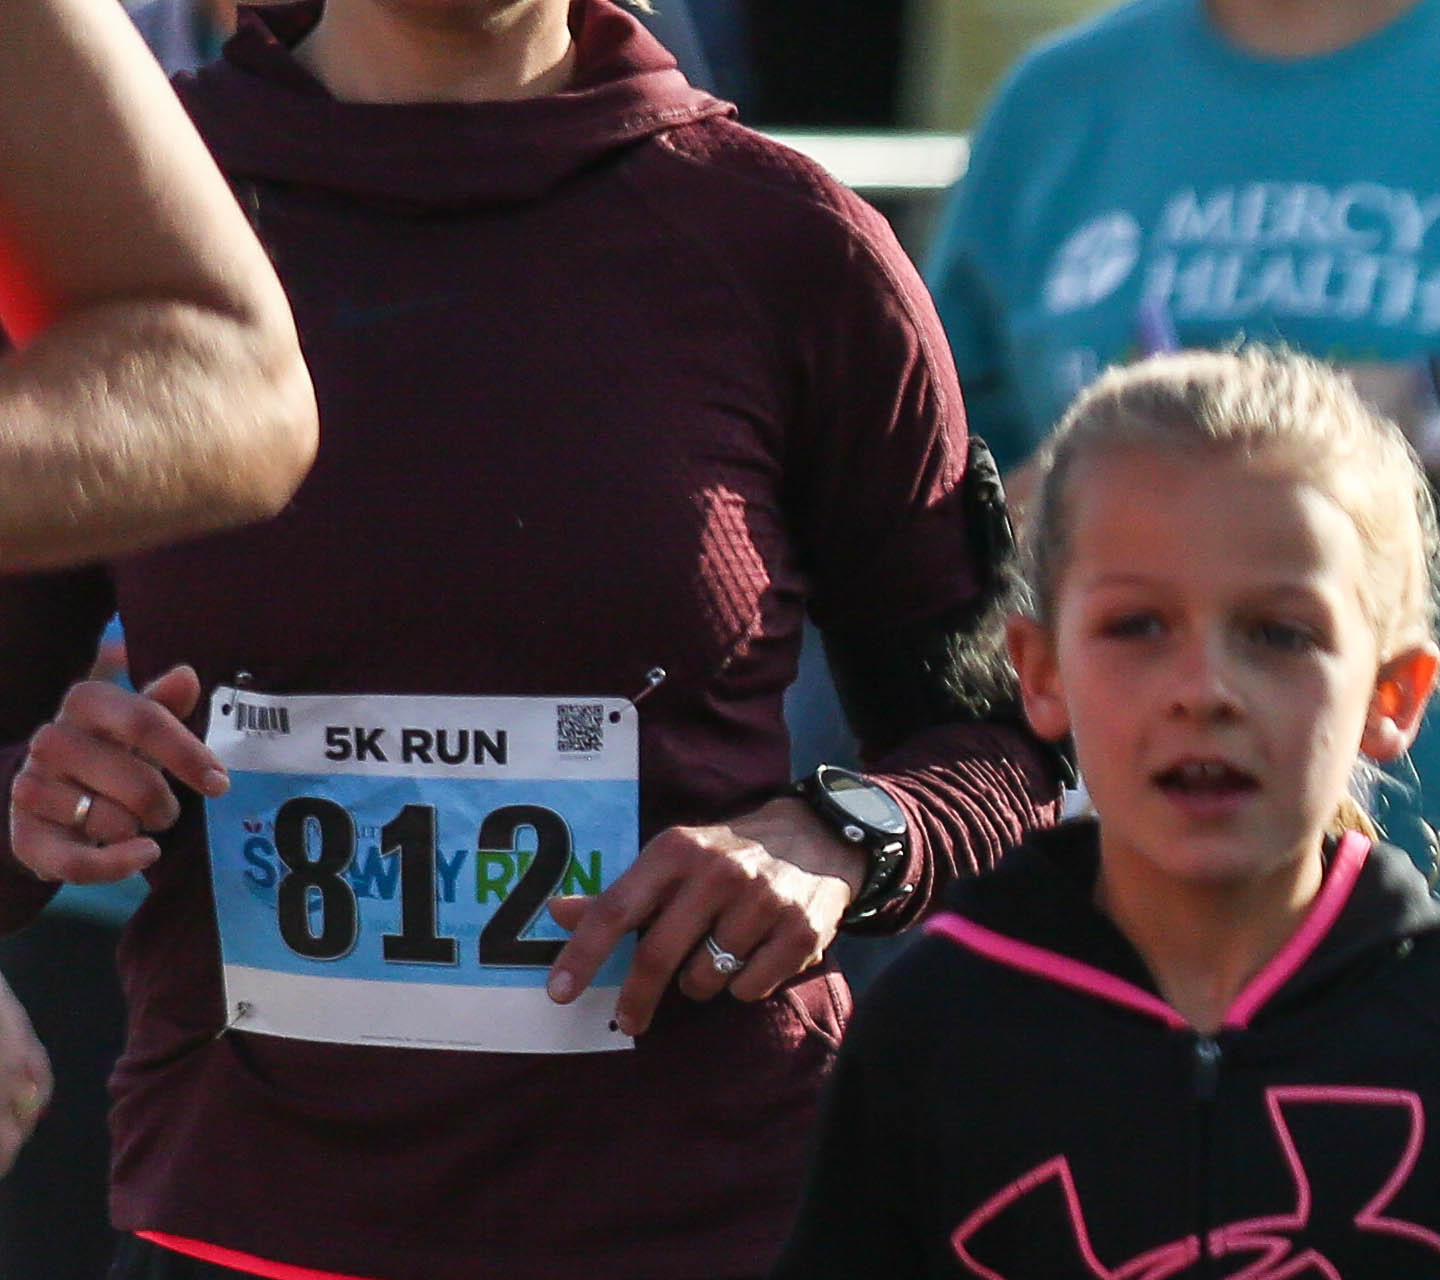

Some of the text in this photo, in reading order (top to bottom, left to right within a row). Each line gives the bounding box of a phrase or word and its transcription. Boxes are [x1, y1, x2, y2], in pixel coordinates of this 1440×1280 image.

[323, 725, 509, 767] 5K RUN
[273, 796, 574, 969] 812
[475, 849, 602, 904] RN
